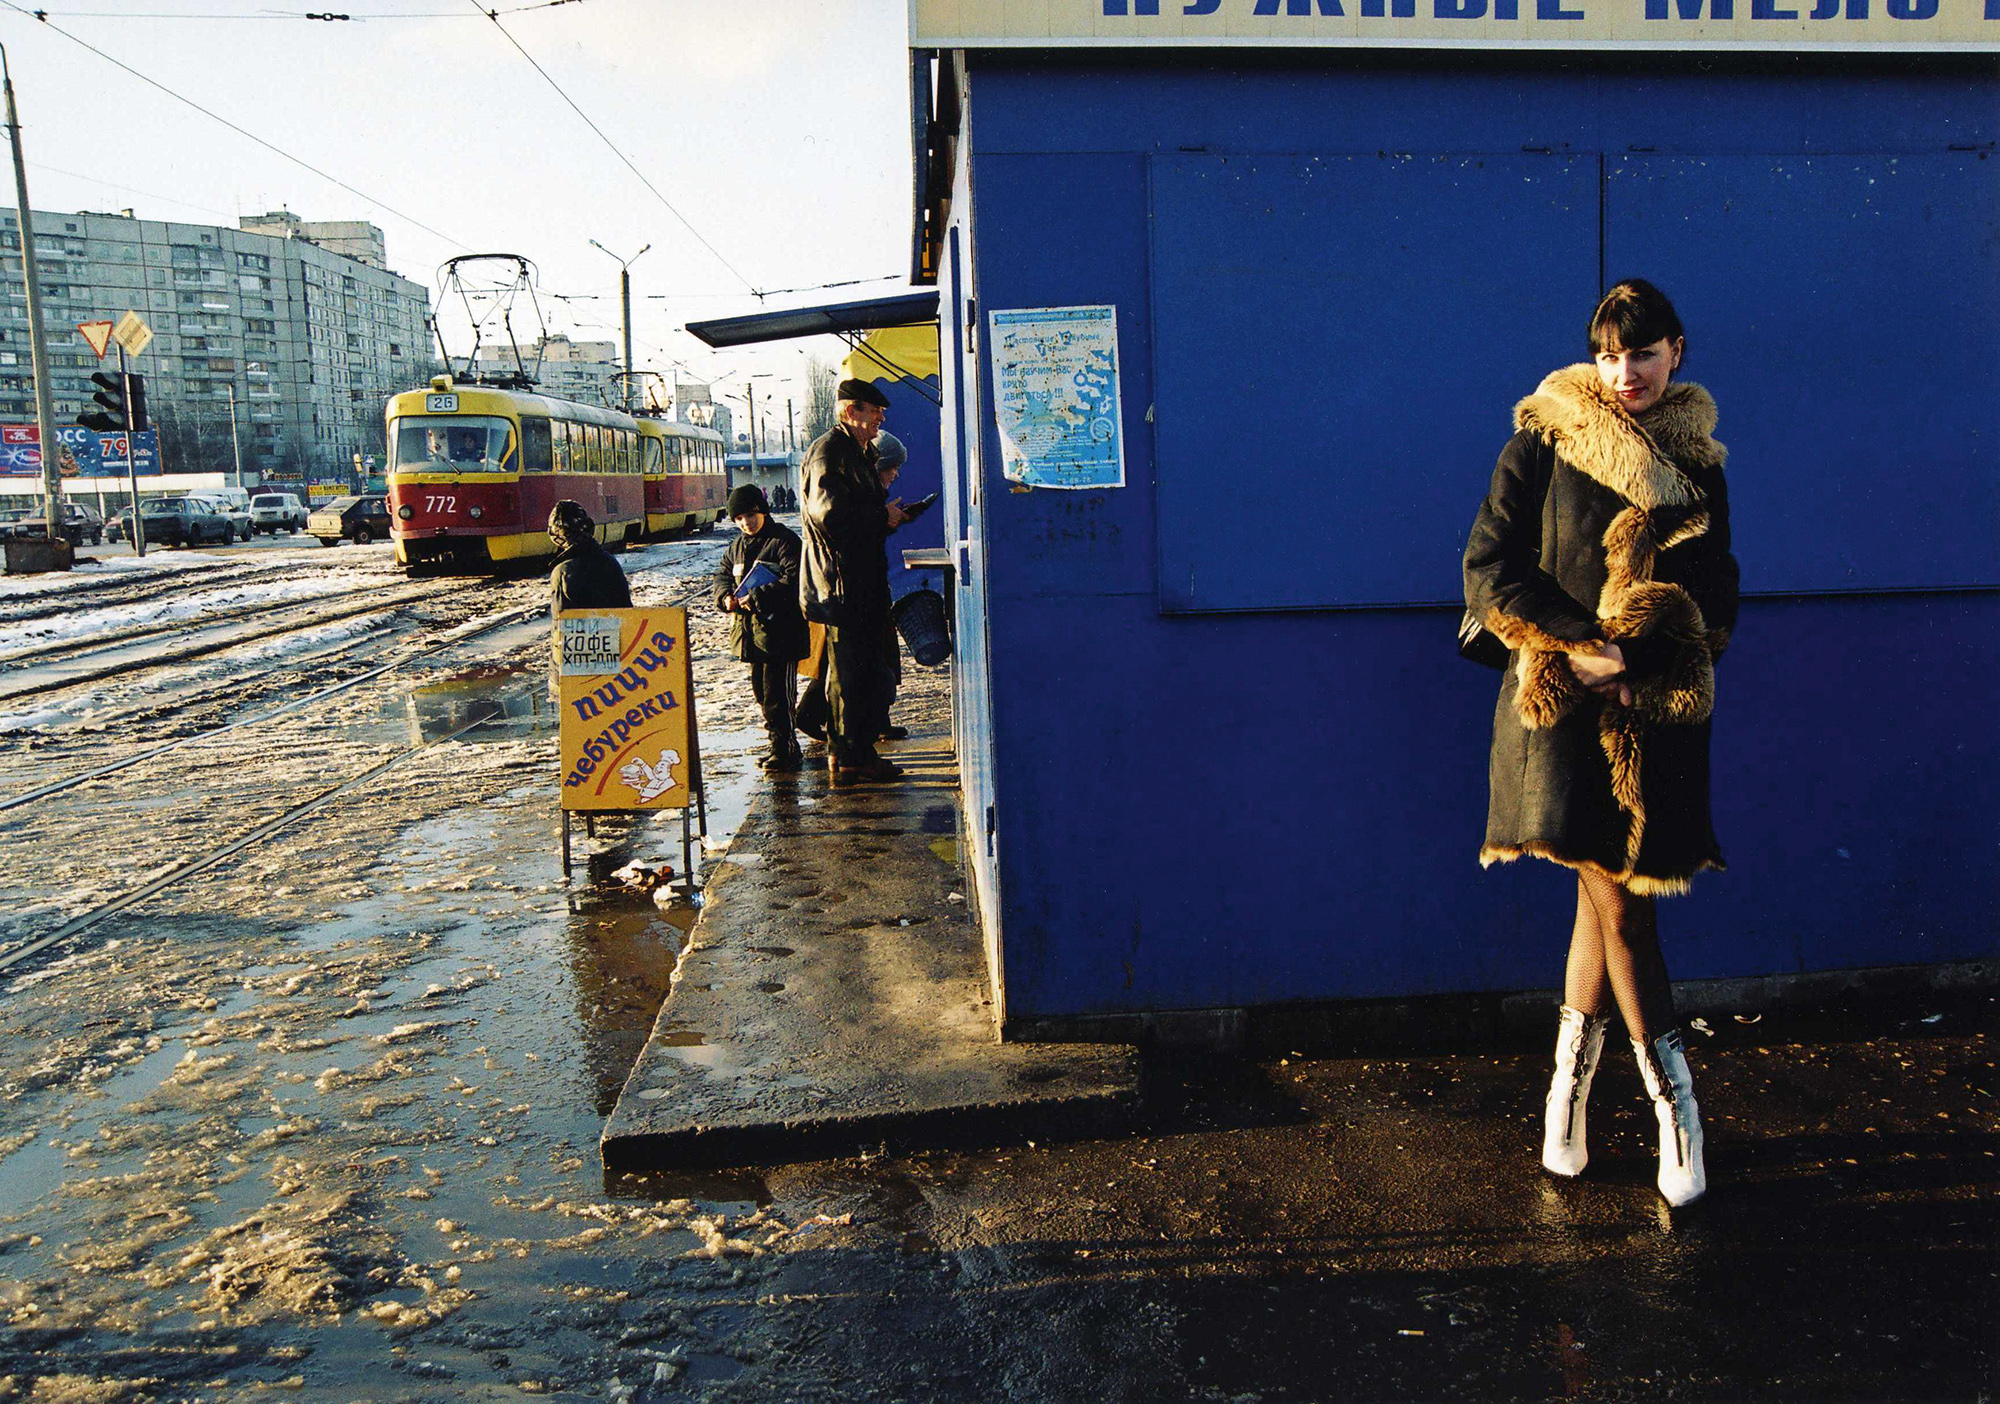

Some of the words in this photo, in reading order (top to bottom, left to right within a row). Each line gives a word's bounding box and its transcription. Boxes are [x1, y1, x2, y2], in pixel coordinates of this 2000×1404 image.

[434, 396, 453, 409] 26
[100, 438, 129, 457] 79
[425, 495, 457, 513] 772
[563, 635, 611, 654] КОФЕ
[571, 631, 676, 721] пицца
[564, 690, 680, 788] чебуреки
